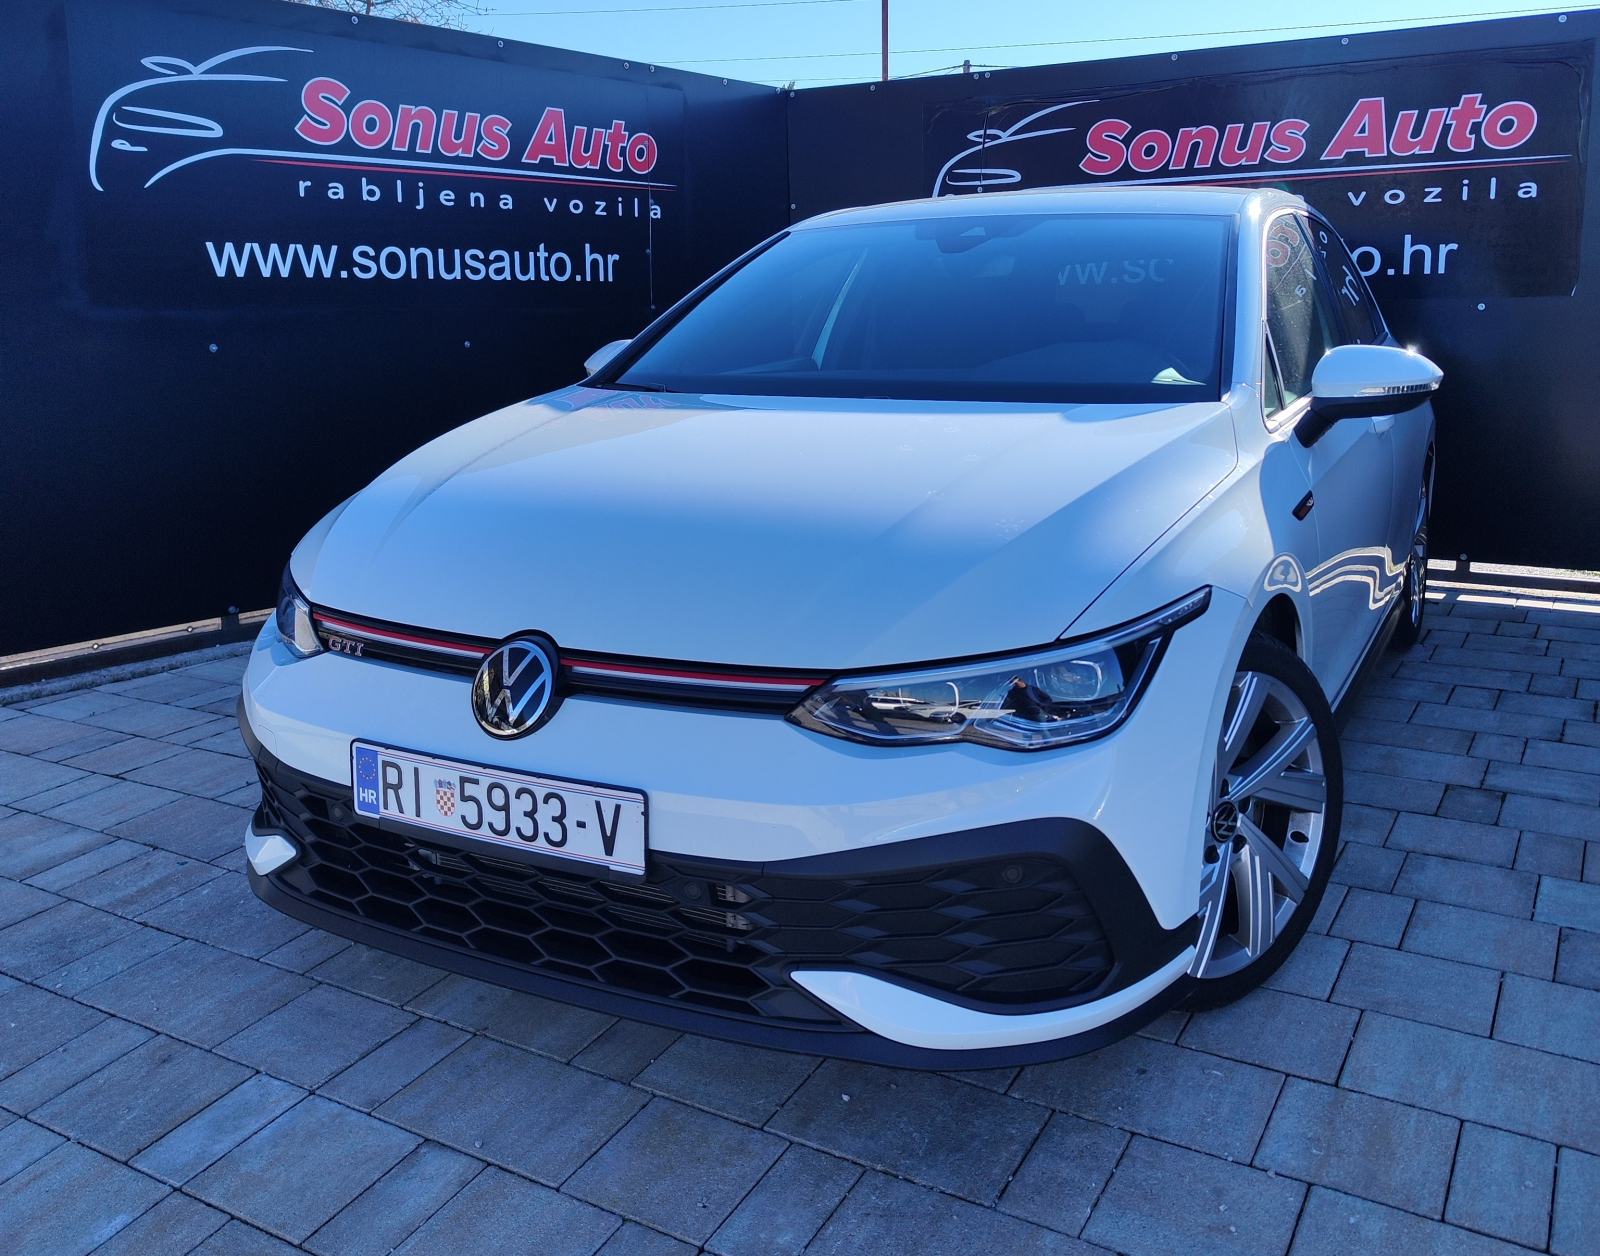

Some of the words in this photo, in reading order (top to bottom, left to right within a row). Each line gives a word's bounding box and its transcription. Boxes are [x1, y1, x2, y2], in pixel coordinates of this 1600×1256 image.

[295, 76, 512, 160] Sonus
[522, 107, 658, 174] Auto
[1079, 118, 1310, 176] Sonus
[1320, 93, 1538, 161] Auto
[298, 177, 514, 210] rabljena
[543, 196, 663, 220] vozila
[1347, 177, 1538, 206] vozila
[205, 241, 619, 282] www.sonusauto.hr
[328, 635, 365, 657] GTI
[359, 786, 377, 806] HR
[380, 759, 422, 818] RI
[459, 775, 622, 857] 5933-V
